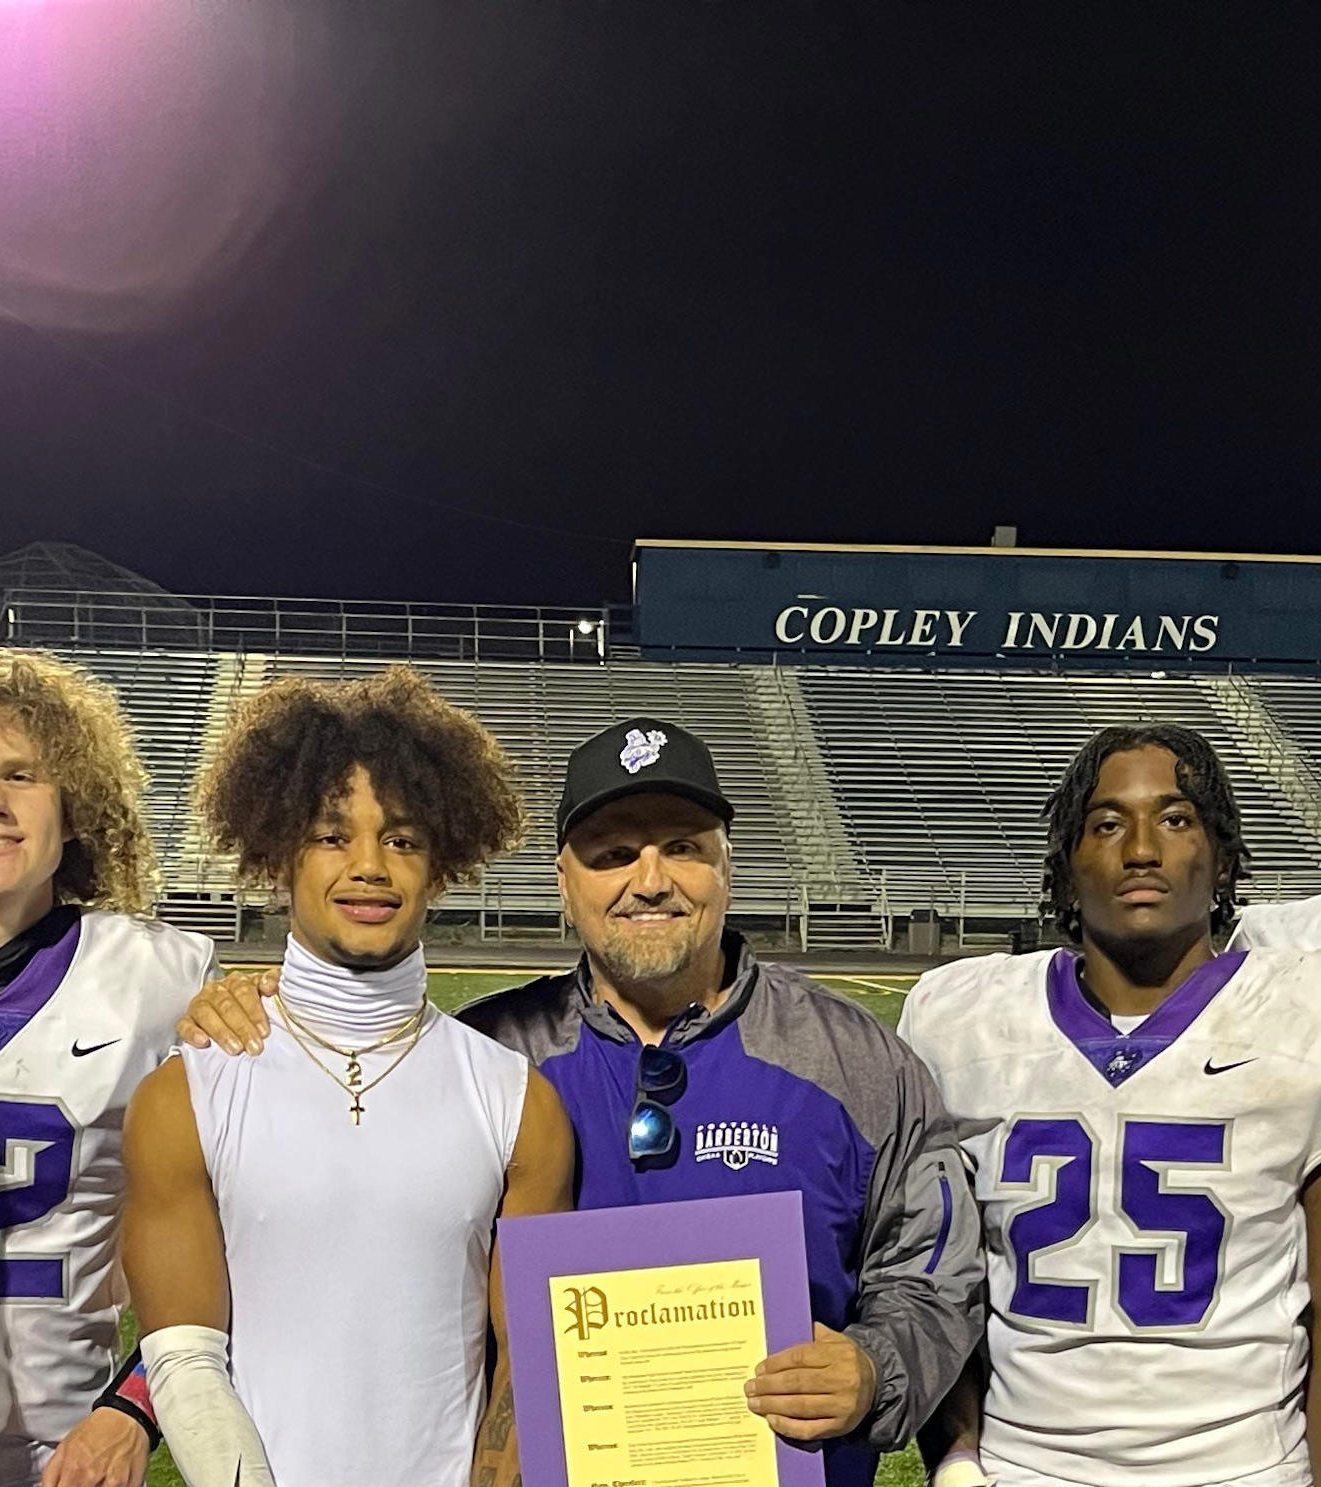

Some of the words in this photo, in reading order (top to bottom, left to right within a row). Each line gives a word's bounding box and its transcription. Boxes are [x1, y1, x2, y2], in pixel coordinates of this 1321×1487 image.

[775, 605, 977, 647] COPLEY
[1000, 611, 1219, 652] INDIANS
[345, 1062, 362, 1087] 2
[994, 1111, 1236, 1333] 25
[563, 1285, 756, 1341] Proclamation
